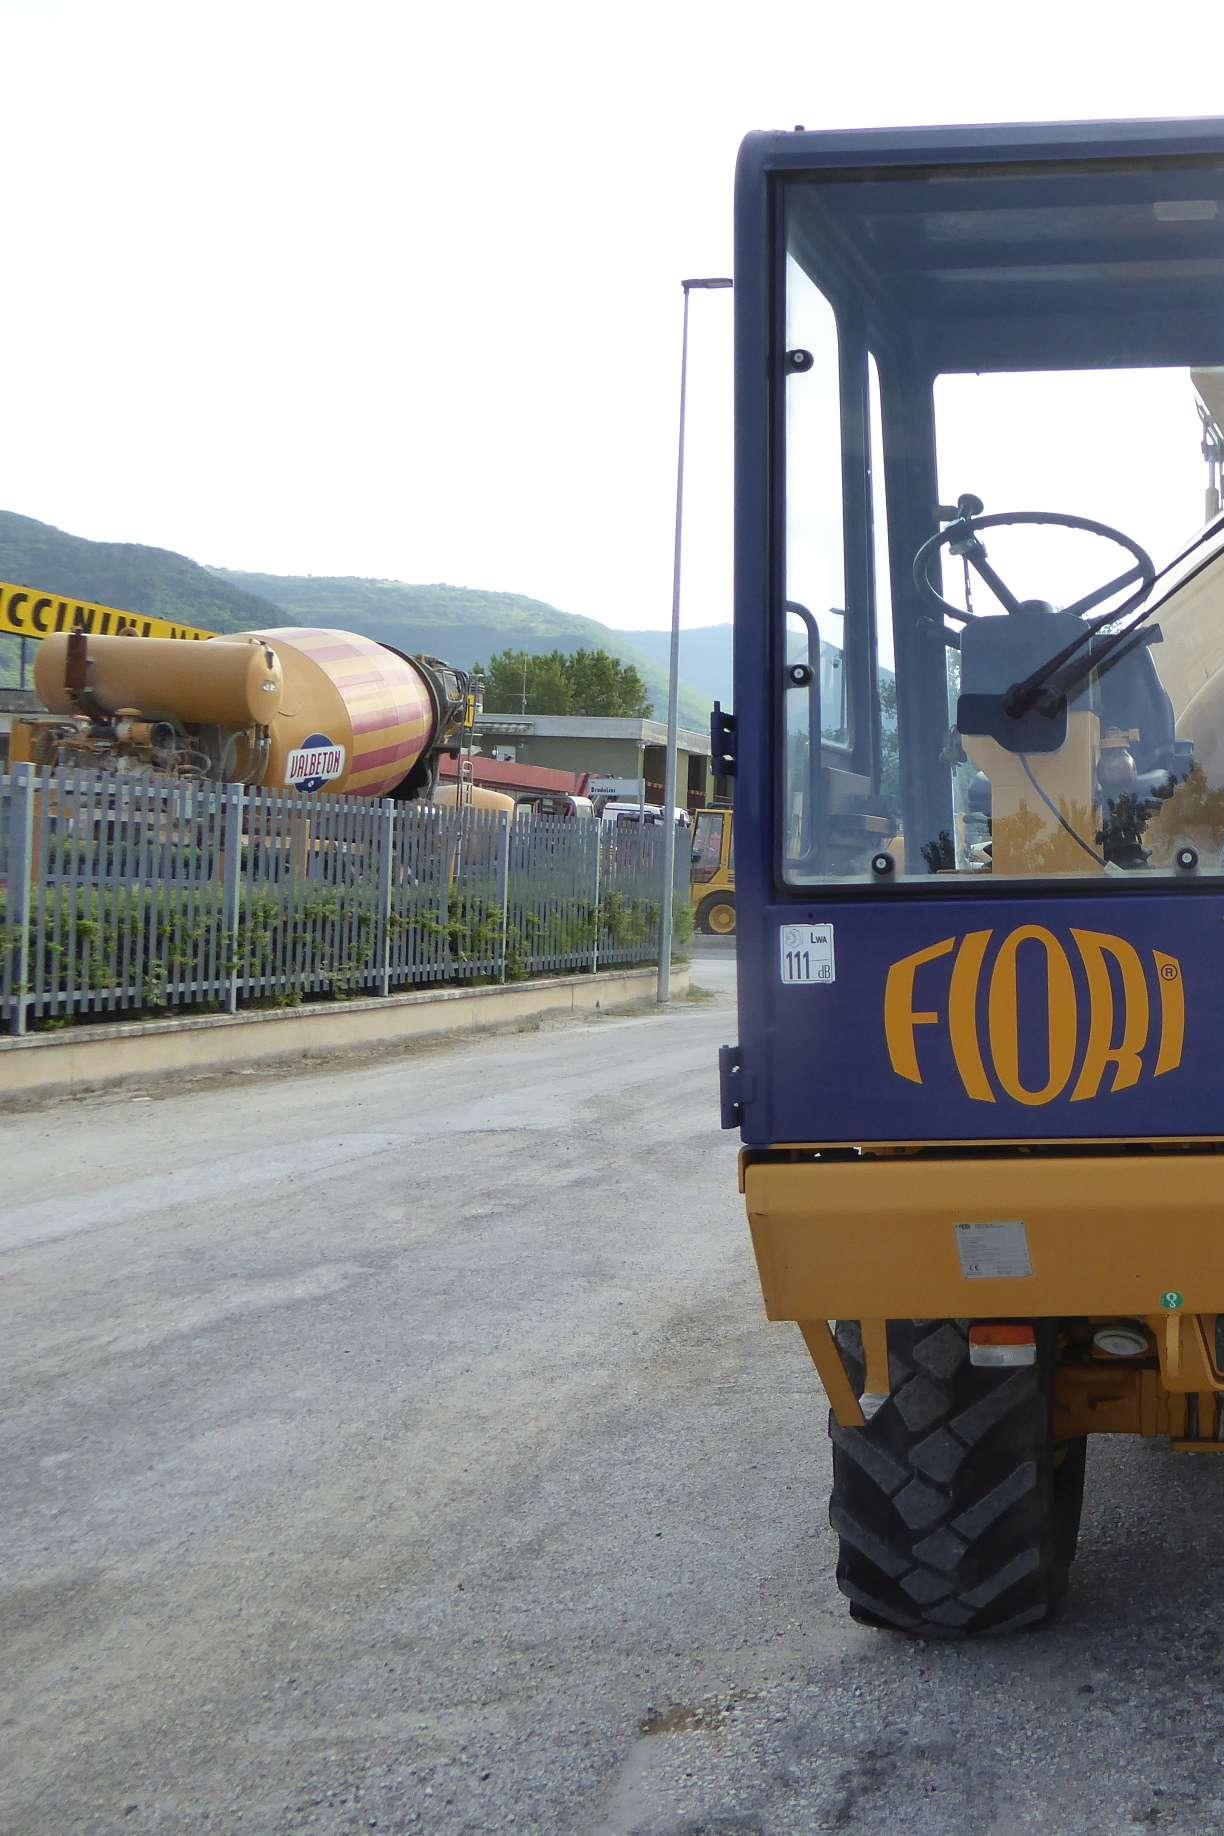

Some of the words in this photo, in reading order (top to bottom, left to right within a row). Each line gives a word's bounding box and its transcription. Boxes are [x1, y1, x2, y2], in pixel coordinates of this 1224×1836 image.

[290, 750, 341, 778] VALBETON
[786, 950, 810, 980] 111
[817, 964, 831, 979] dB
[884, 924, 1185, 1106] FIORI
